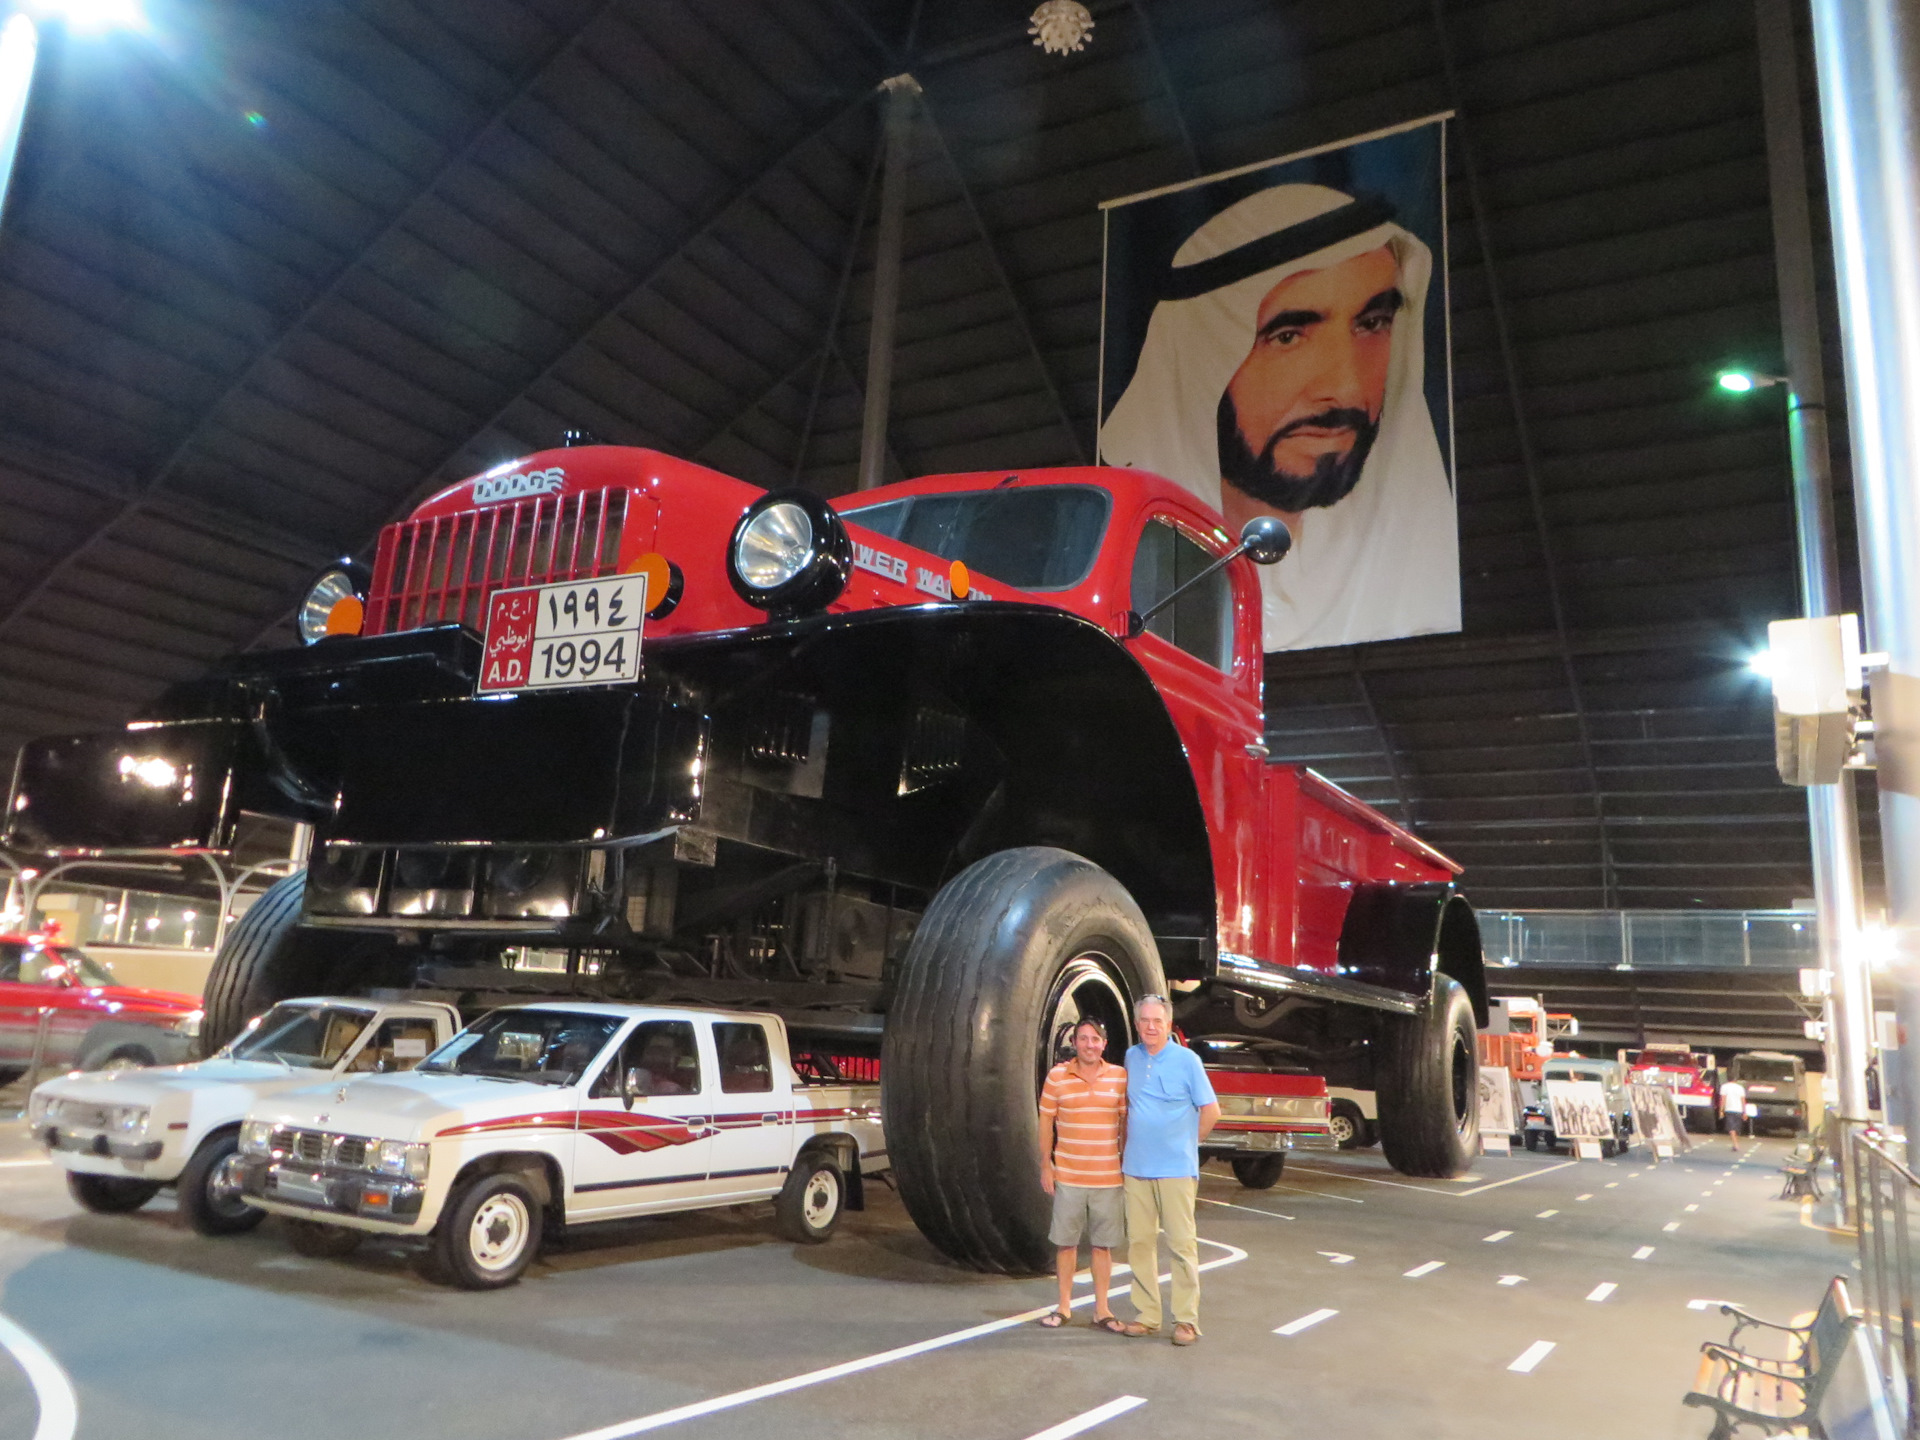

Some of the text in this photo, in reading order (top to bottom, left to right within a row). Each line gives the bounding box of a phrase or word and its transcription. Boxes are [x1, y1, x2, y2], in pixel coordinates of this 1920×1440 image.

[472, 466, 565, 505] DODGE
[549, 585, 628, 632] ١٩٩٤
[487, 658, 523, 683] A.D.
[541, 636, 626, 679] 1994
